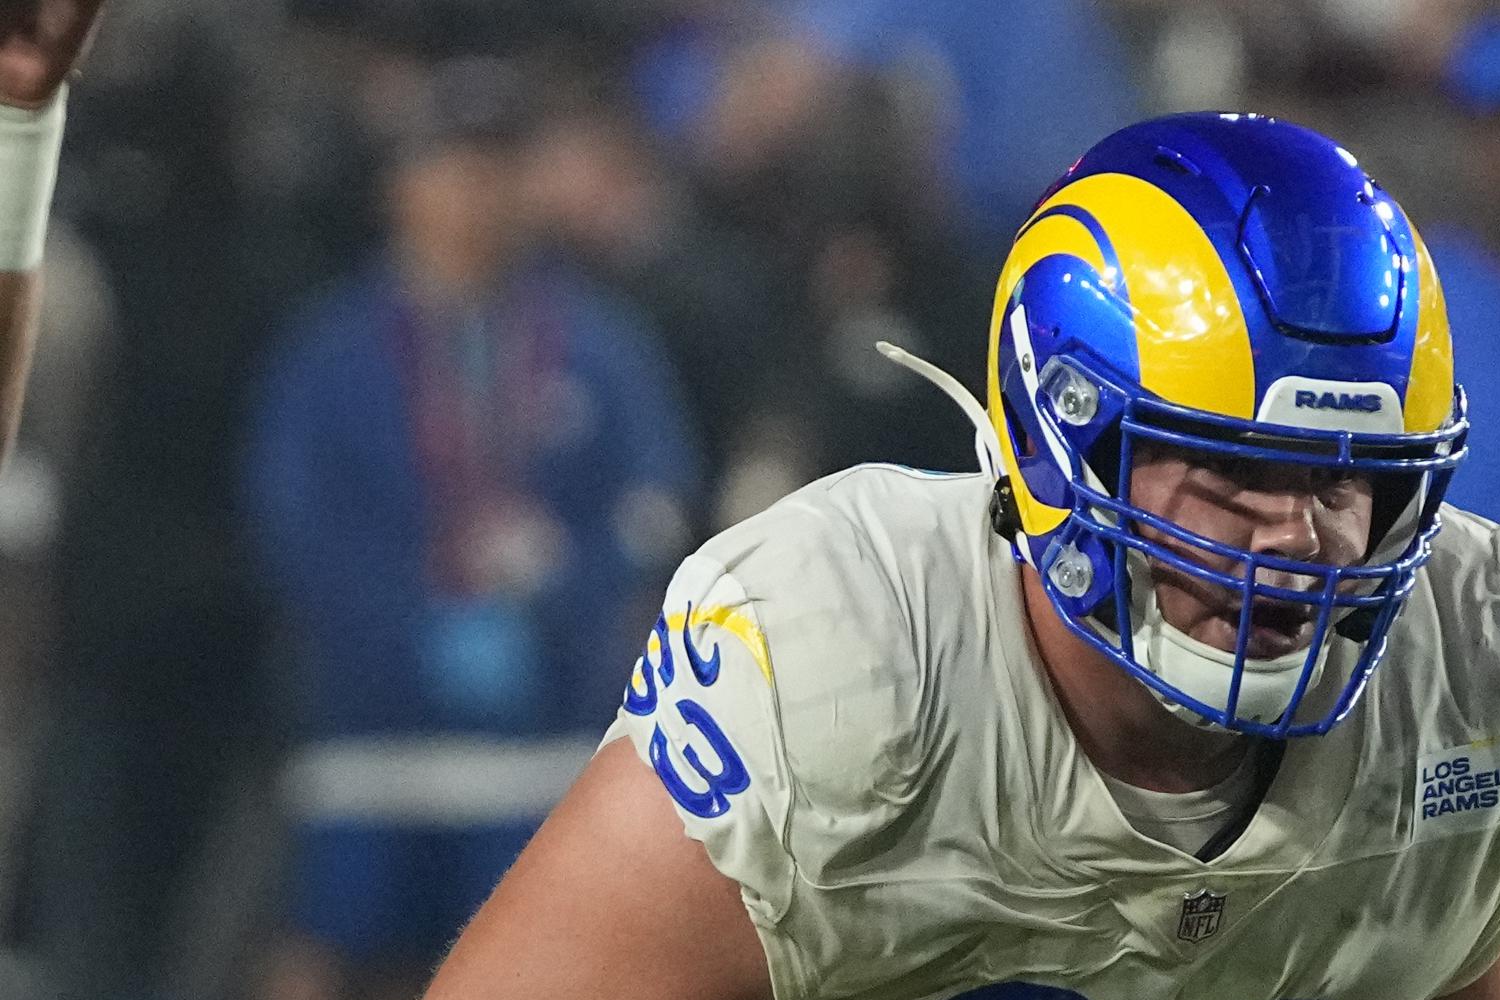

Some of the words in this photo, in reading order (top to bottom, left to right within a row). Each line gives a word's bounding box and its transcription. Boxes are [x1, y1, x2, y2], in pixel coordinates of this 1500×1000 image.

[1294, 388, 1383, 413] RAMS
[1423, 757, 1470, 783] LOS
[1423, 790, 1498, 820] RAMS
